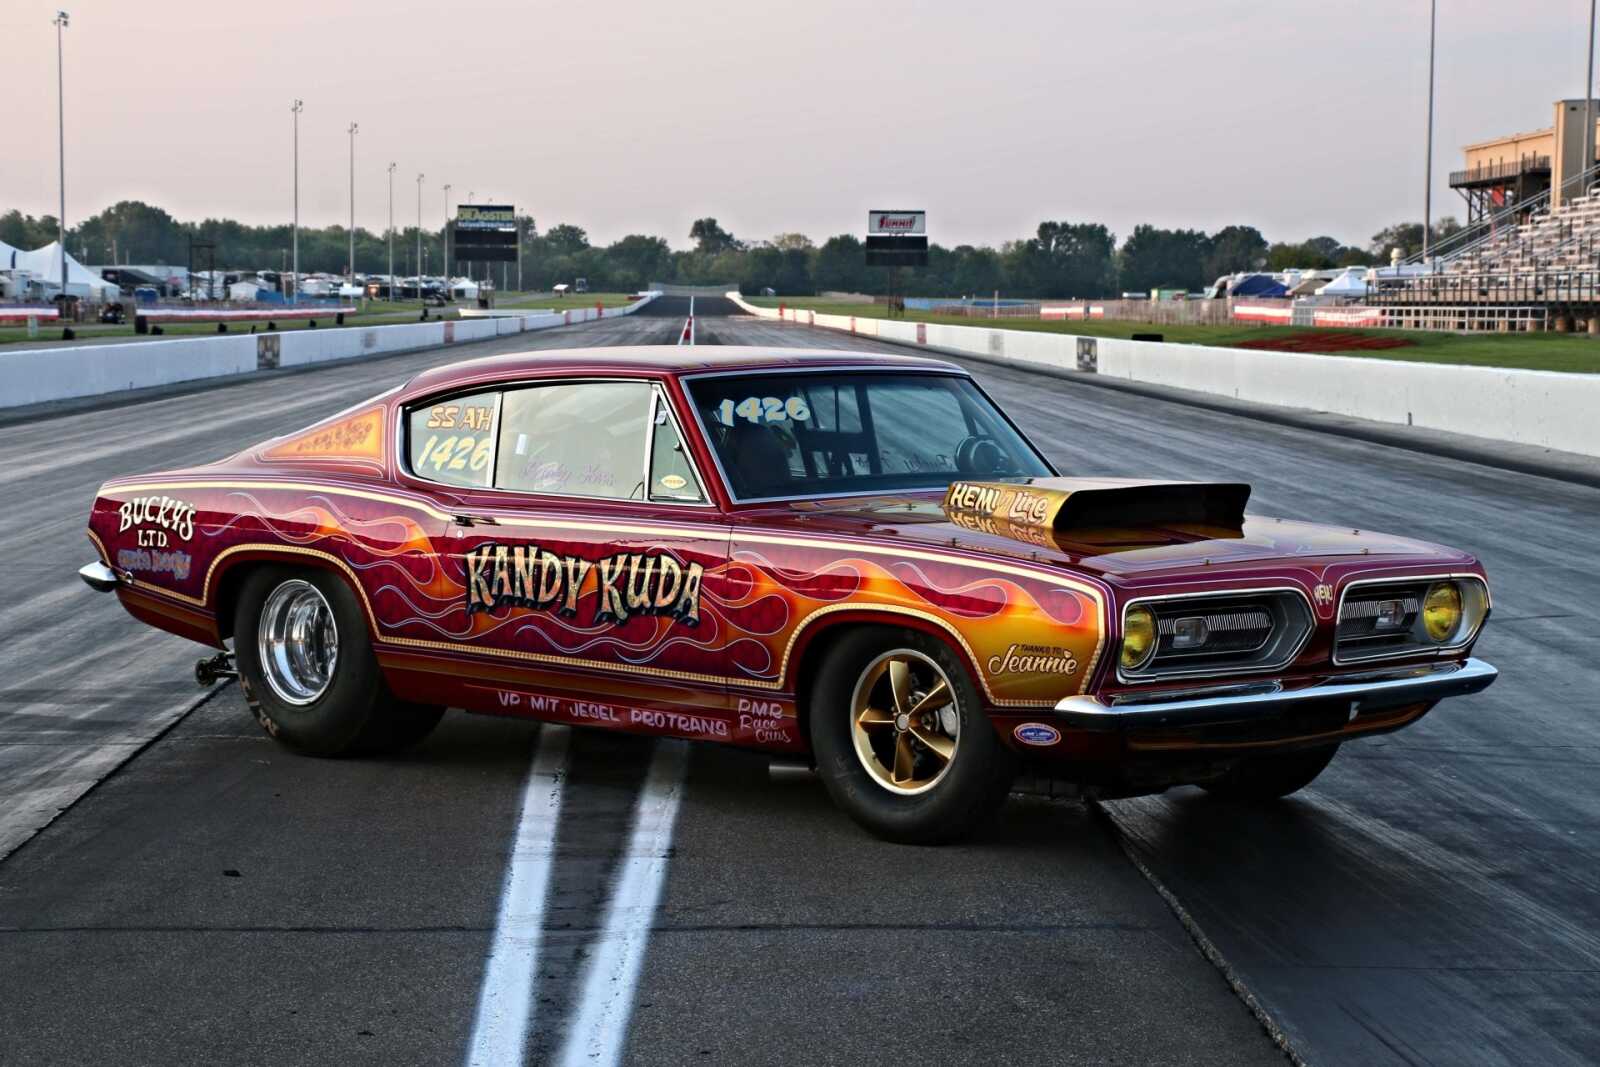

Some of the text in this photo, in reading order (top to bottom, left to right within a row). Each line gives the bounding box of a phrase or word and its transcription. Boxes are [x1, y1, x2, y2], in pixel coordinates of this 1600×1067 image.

[426, 405, 459, 429] SS
[719, 396, 811, 427] 1426
[416, 435, 491, 471] 1426
[950, 483, 1001, 514] HEMI
[118, 495, 196, 541] BUCKY'S
[138, 529, 170, 547] LTD.
[465, 545, 705, 626] KANDY KUDA
[988, 643, 1078, 675] Jeannie
